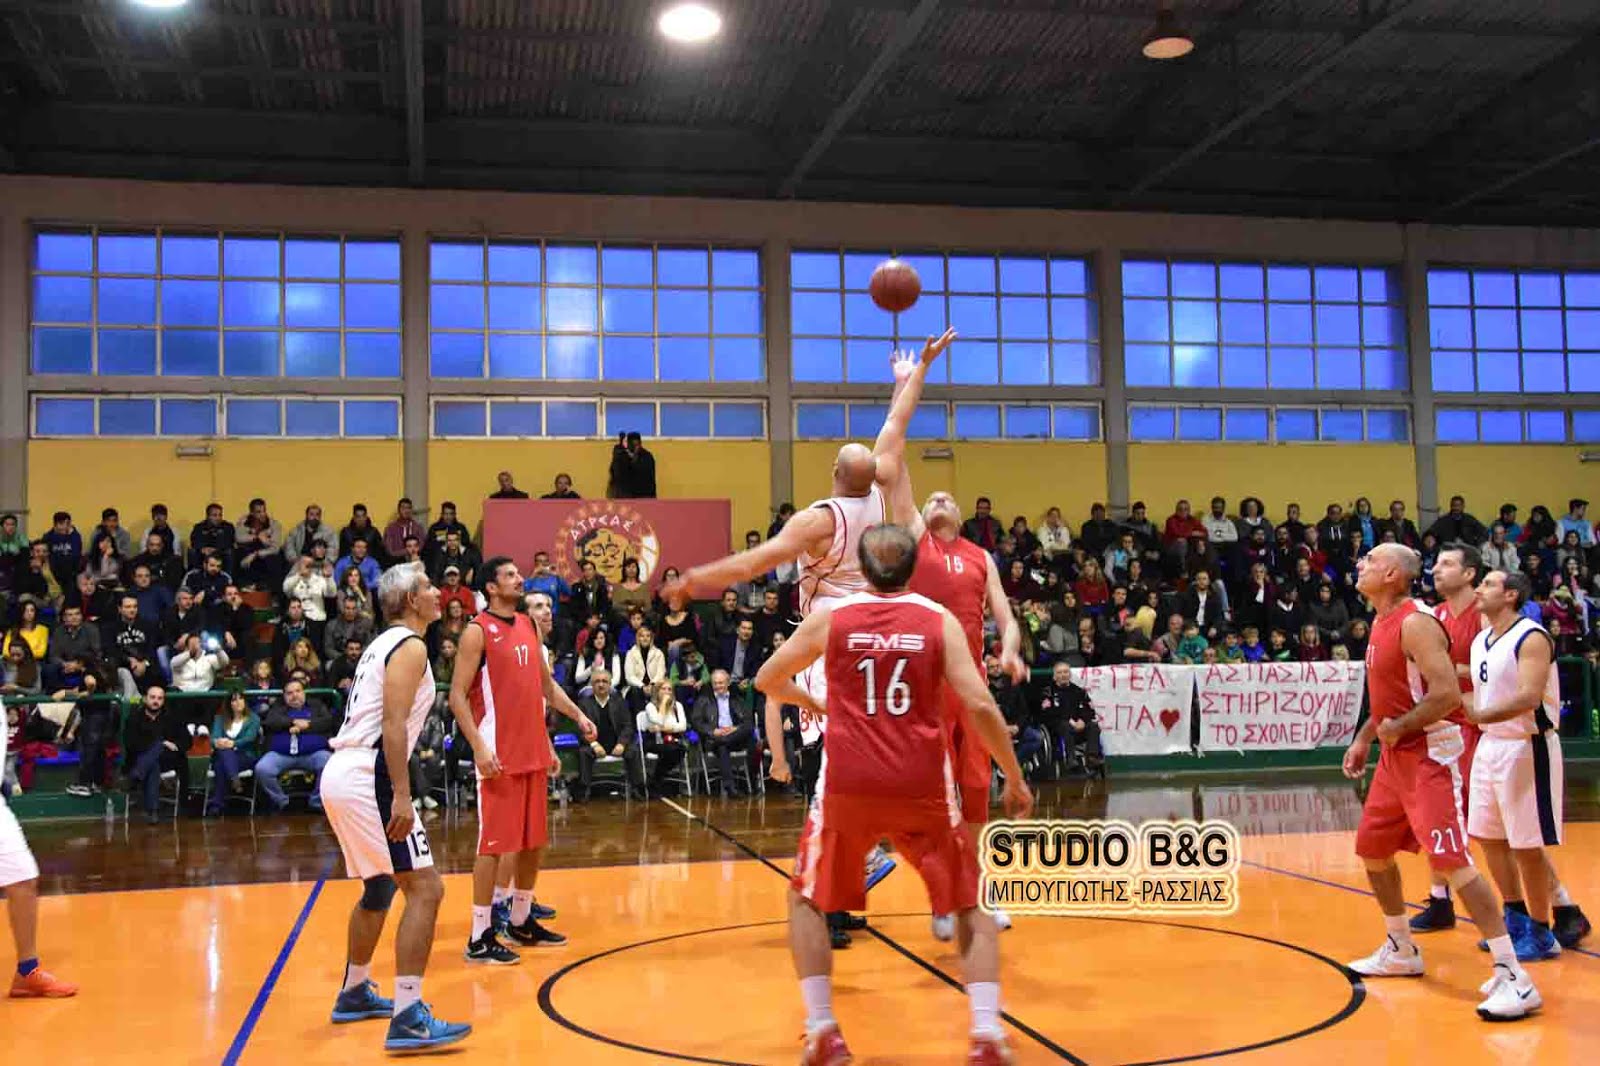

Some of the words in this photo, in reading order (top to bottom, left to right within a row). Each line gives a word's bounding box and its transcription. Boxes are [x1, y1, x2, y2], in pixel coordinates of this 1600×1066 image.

[943, 554, 964, 574] 15
[846, 632, 926, 652] FMS
[514, 644, 529, 666] 17
[1111, 664, 1165, 691] ΓΕΛ
[1479, 661, 1489, 684] 8
[857, 657, 911, 717] 16
[1201, 690, 1359, 719] ΣΤΗΡΙΖΟΥΜΕ
[1210, 722, 1237, 746] ΤΟ
[1243, 720, 1321, 745] ΣΧΟΛΕΙΟ
[410, 831, 430, 858] 13
[1431, 828, 1459, 853] 21
